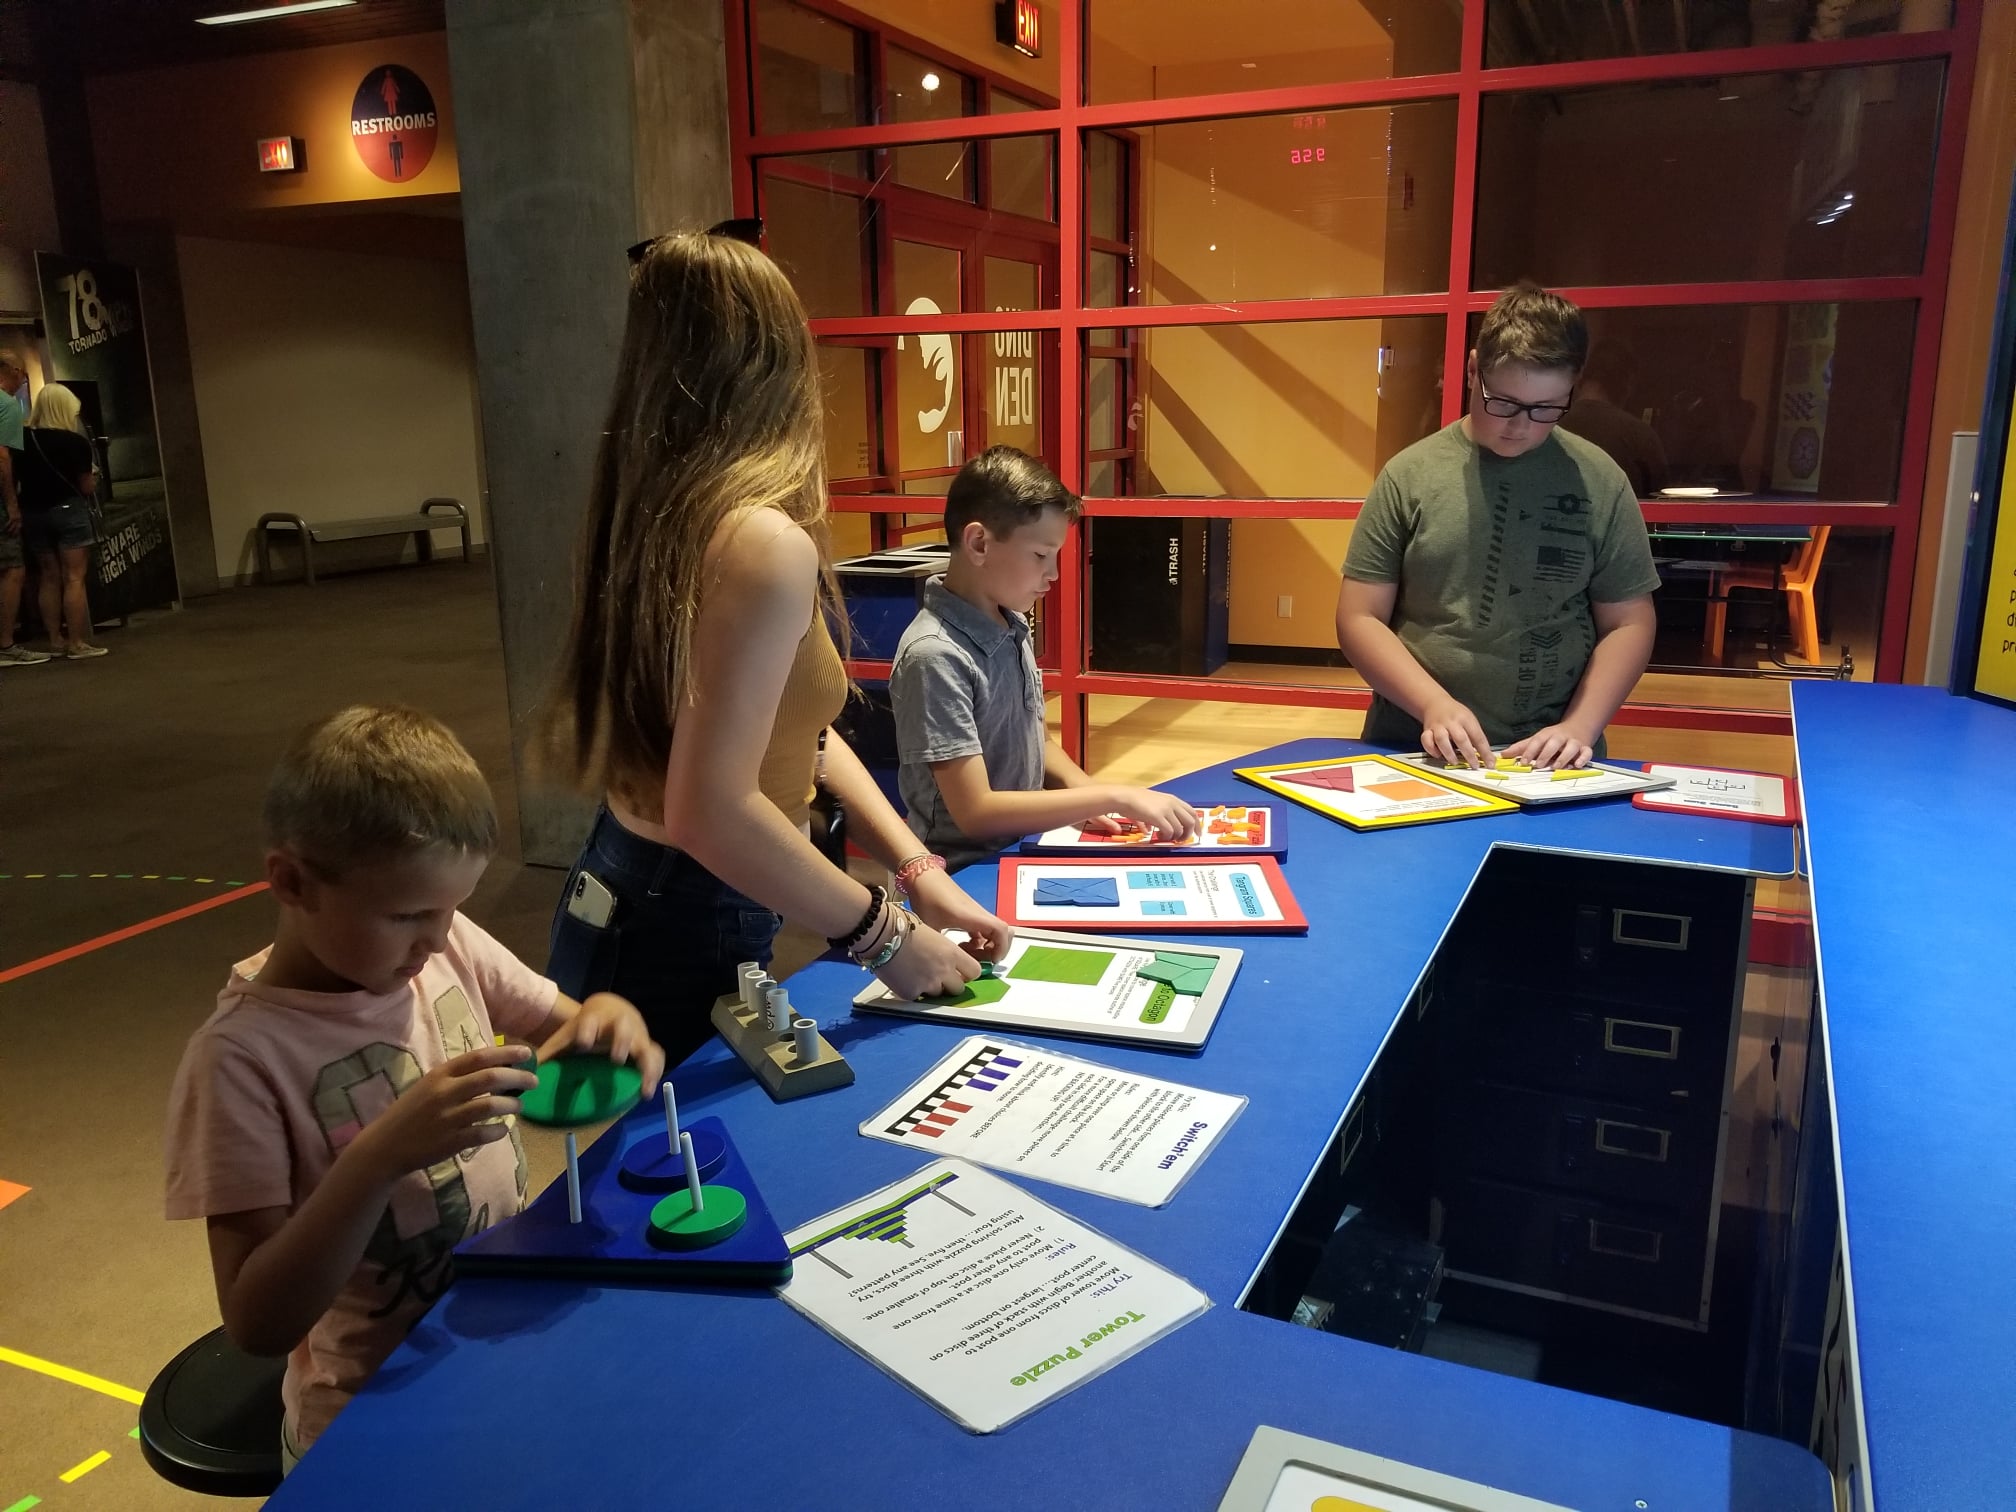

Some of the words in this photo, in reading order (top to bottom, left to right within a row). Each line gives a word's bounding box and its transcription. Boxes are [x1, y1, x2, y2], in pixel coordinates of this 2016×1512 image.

[1018, 0, 1038, 50] EXIT
[352, 112, 435, 136] RESTROOMS
[57, 269, 102, 339] 78
[68, 328, 108, 355] TORNADO
[1169, 538, 1178, 576] TRASH
[1147, 995, 1170, 1021] Octagon
[990, 1210, 1014, 1223] using
[1003, 1215, 1024, 1228] After
[971, 1227, 1002, 1245] solving
[1008, 1233, 1033, 1248] Never
[944, 1238, 966, 1248] then
[1022, 1238, 1041, 1250] post
[925, 1248, 946, 1256] five.
[944, 1243, 972, 1259] puzzle
[984, 1246, 1007, 1260] place
[1028, 1244, 1053, 1258] Move
[1045, 1243, 1076, 1260] Rules:
[909, 1257, 926, 1266] See
[924, 1259, 944, 1269] with
[996, 1255, 1012, 1265] any
[1009, 1258, 1028, 1269] only
[1071, 1256, 1096, 1272] center
[892, 1266, 908, 1275] any
[959, 1264, 977, 1273] disc
[972, 1264, 996, 1278] other
[992, 1269, 1009, 1278] one
[1072, 1261, 1107, 1282] another.
[1095, 1267, 1120, 1282] Move
[898, 1269, 924, 1282] three
[949, 1276, 972, 1288] post.
[1113, 1274, 1132, 1284] Try
[848, 1273, 891, 1297] patterns?
[872, 1282, 898, 1293] discs,
[930, 1280, 948, 1288] top
[974, 1278, 992, 1288] disc
[1048, 1282, 1075, 1296] Begin
[1071, 1282, 1096, 1297] tower
[1012, 1287, 1044, 1305] largest
[1090, 1284, 1117, 1298] This:
[858, 1294, 873, 1302] try
[886, 1293, 919, 1311] smaller
[935, 1297, 958, 1308] time
[1028, 1297, 1048, 1308] with
[1060, 1296, 1070, 1304] of
[863, 1310, 884, 1320] one.
[912, 1308, 936, 1320] from
[1004, 1308, 1028, 1322] stack
[1038, 1302, 1060, 1315] discs
[893, 1320, 911, 1329] one
[962, 1311, 1001, 1330] bottom.
[994, 1321, 1004, 1329] of
[1016, 1314, 1040, 1327] from
[968, 1327, 994, 1340] three
[998, 1327, 1016, 1337] one
[1080, 1311, 1145, 1348] Tower
[944, 1341, 968, 1354] discs
[976, 1336, 998, 1349] post
[1010, 1346, 1082, 1386] Puzzle
